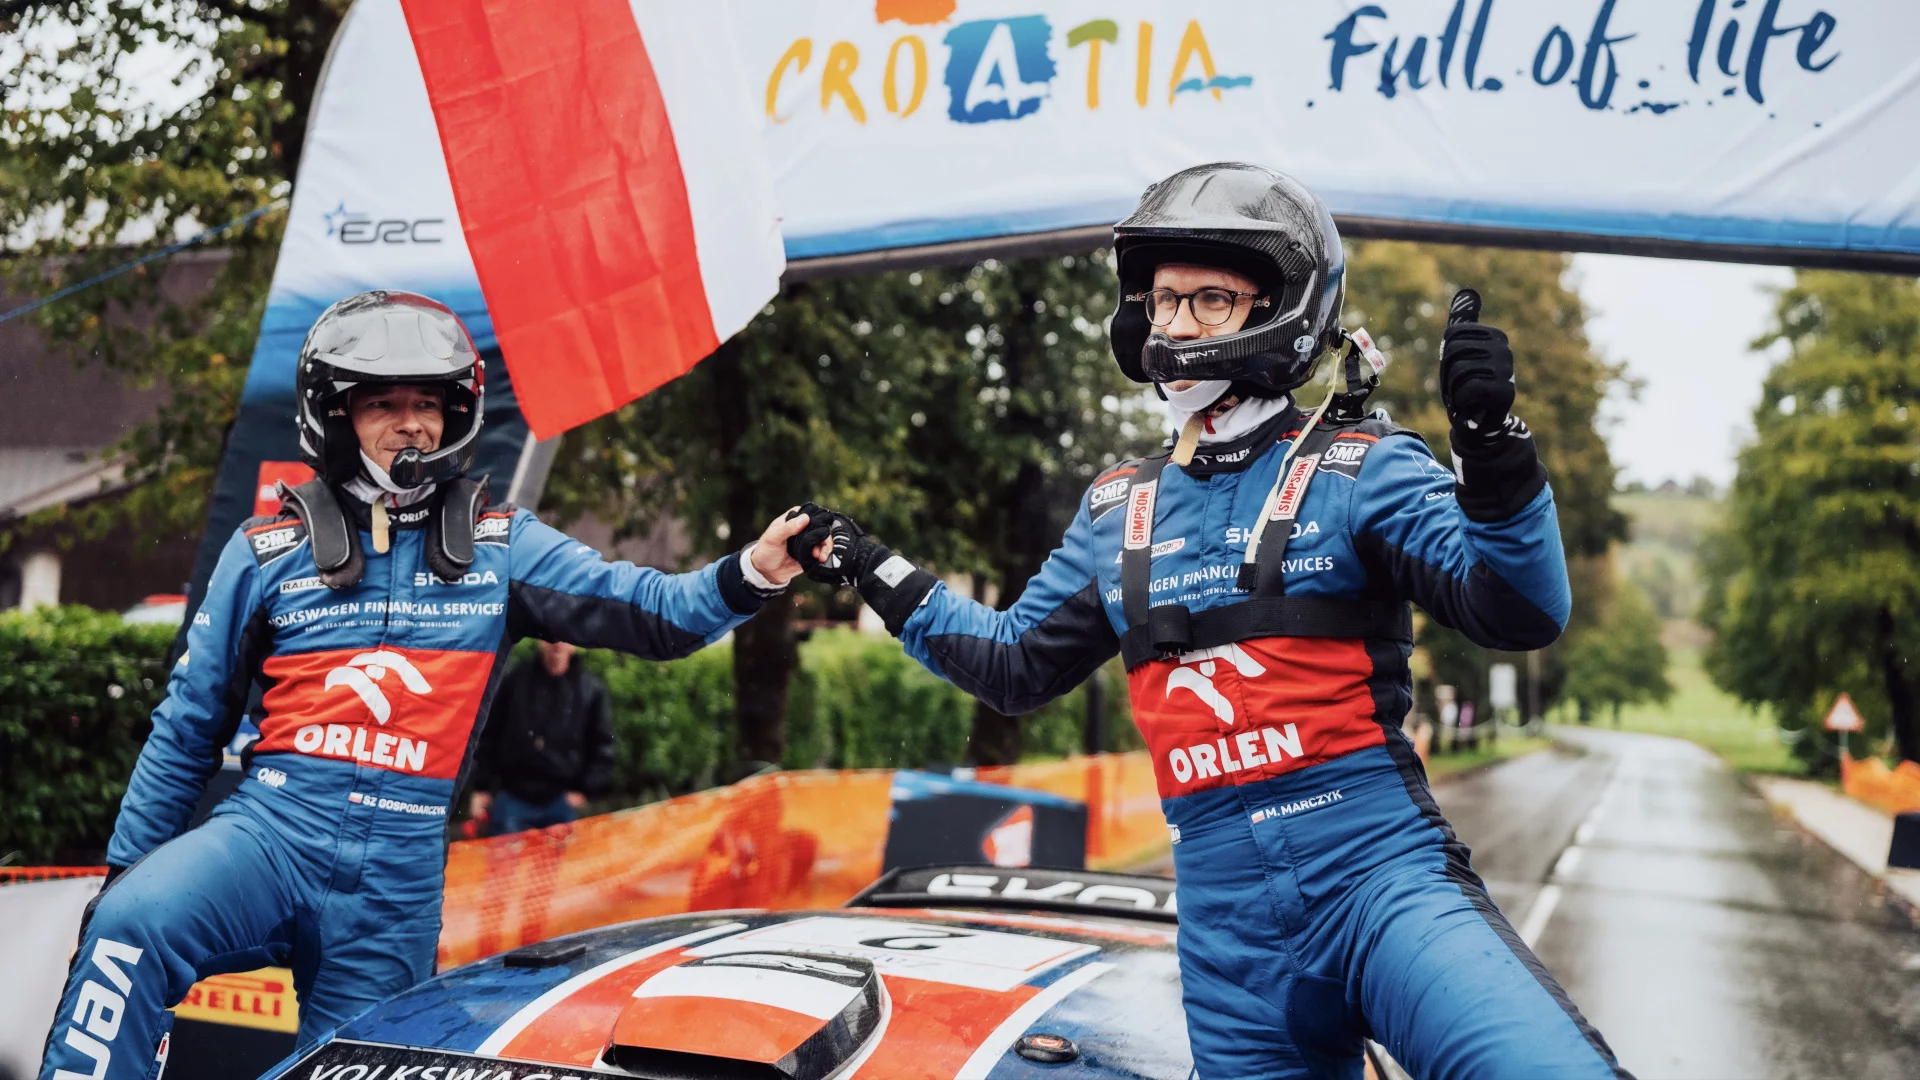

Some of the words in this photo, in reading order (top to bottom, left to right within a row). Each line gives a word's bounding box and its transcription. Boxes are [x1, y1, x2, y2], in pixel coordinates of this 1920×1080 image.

[764, 15, 1225, 124] CROATIA
[1532, 0, 1637, 110] of
[1689, 0, 1841, 104] life
[340, 219, 445, 244] ERC
[1325, 446, 1366, 461] OMP
[1091, 482, 1129, 504] OMP
[1278, 463, 1309, 512] SIMPSON
[1131, 491, 1150, 541] SIMPSON
[254, 531, 297, 550] OMP
[364, 601, 440, 616] FINANCIAL
[443, 603, 505, 616] SERVICES
[293, 723, 428, 772] ORLEN
[1169, 722, 1305, 784] ORLEN
[256, 767, 287, 788] OMP
[363, 795, 377, 807] SZ
[378, 798, 447, 816] GOSPODARCZYK
[1264, 807, 1281, 819] M.
[1281, 789, 1343, 816] MARCZYK
[182, 988, 282, 1017] RELLI
